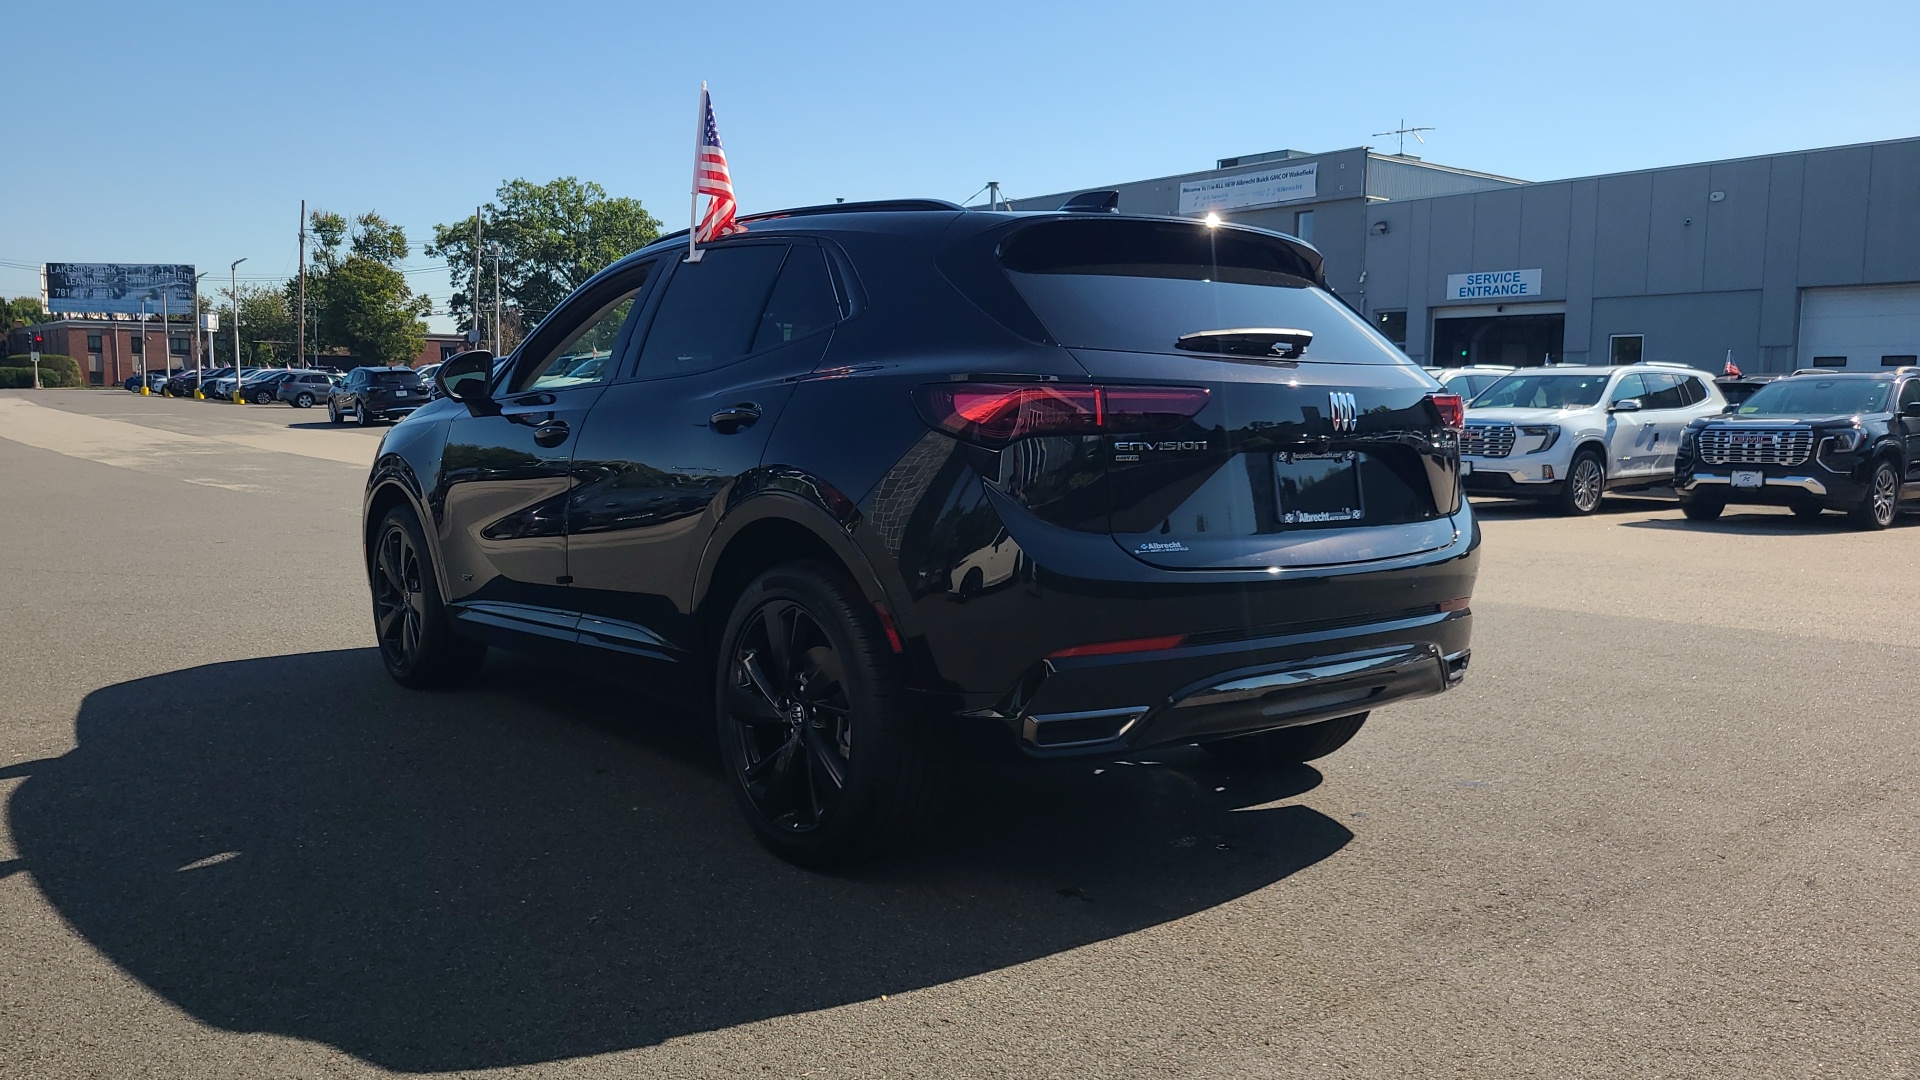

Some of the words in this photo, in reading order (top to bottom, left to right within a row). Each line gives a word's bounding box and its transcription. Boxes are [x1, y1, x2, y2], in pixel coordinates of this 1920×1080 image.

[1256, 176, 1270, 184] Buick
[1289, 169, 1314, 178] Wakefield
[1276, 184, 1303, 193] Albrecht
[50, 265, 93, 275] LAKESIDE
[1467, 271, 1521, 285] SERVICE
[1459, 283, 1527, 297] ENTRANCE
[1114, 441, 1207, 451] ENVISION
[1299, 512, 1330, 522] Albrecht
[1149, 541, 1181, 549] Albrecht
